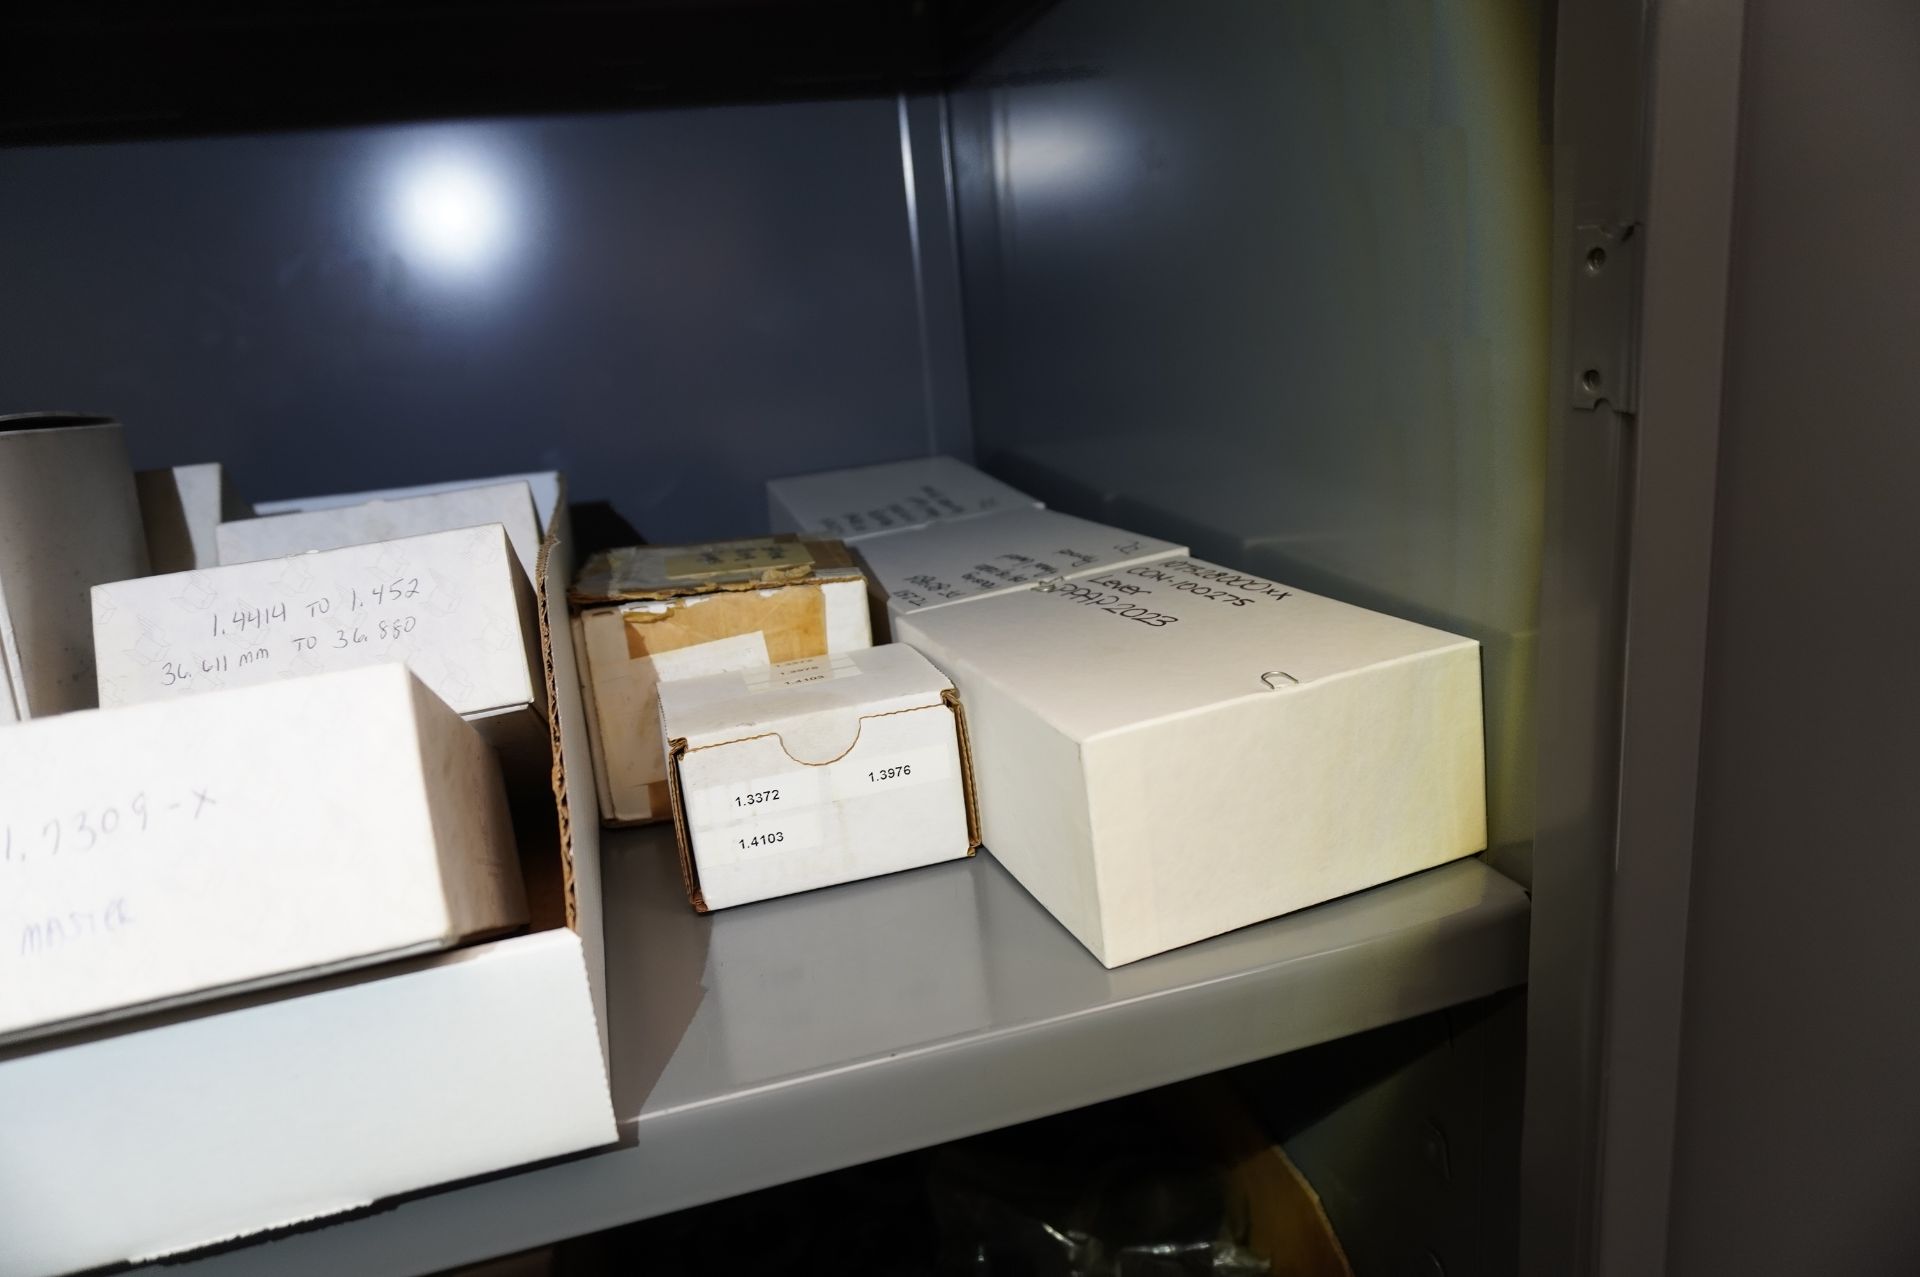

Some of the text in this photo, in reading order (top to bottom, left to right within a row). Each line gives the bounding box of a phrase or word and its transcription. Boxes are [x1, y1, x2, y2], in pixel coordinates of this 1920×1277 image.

[1086, 574, 1153, 597] Lever
[212, 577, 421, 638] 1.4414 TO 1.452
[291, 634, 318, 652] TO
[333, 615, 417, 650] 36.880
[868, 763, 912, 783] 1.3976
[734, 788, 781, 808] 1.3372
[738, 830, 785, 850] 1.4103
